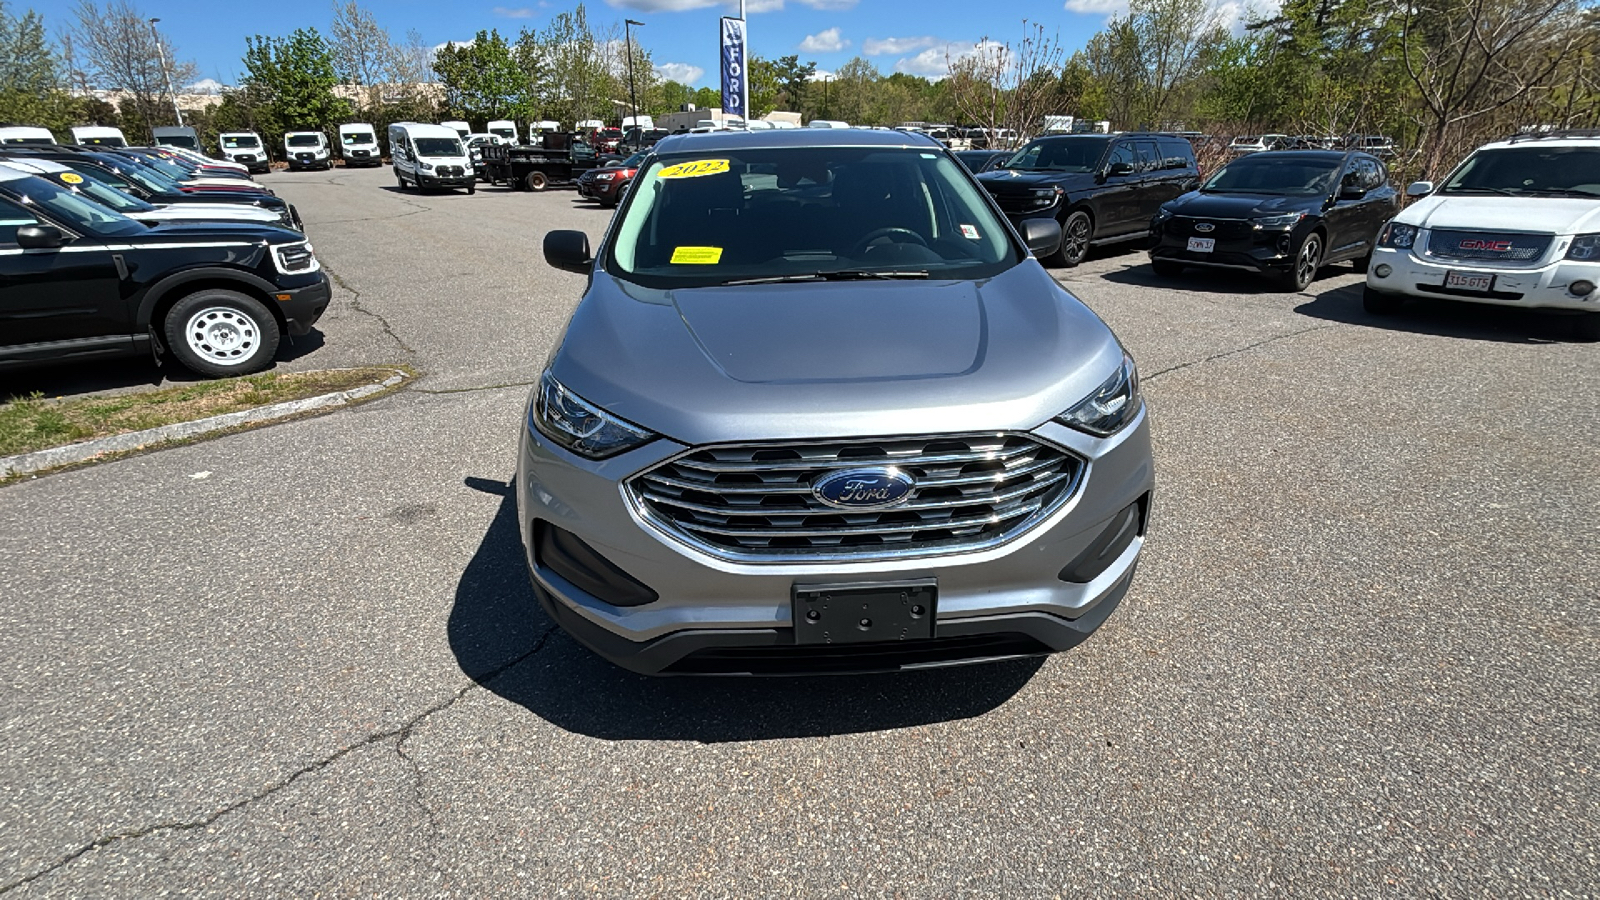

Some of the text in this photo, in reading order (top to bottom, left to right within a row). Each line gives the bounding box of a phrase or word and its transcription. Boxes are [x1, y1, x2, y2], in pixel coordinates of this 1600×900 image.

[729, 47, 740, 108] FORD
[667, 161, 725, 176] 2022
[1459, 239, 1512, 252] GMC
[1448, 276, 1467, 286] 315
[839, 479, 892, 501] Ford
